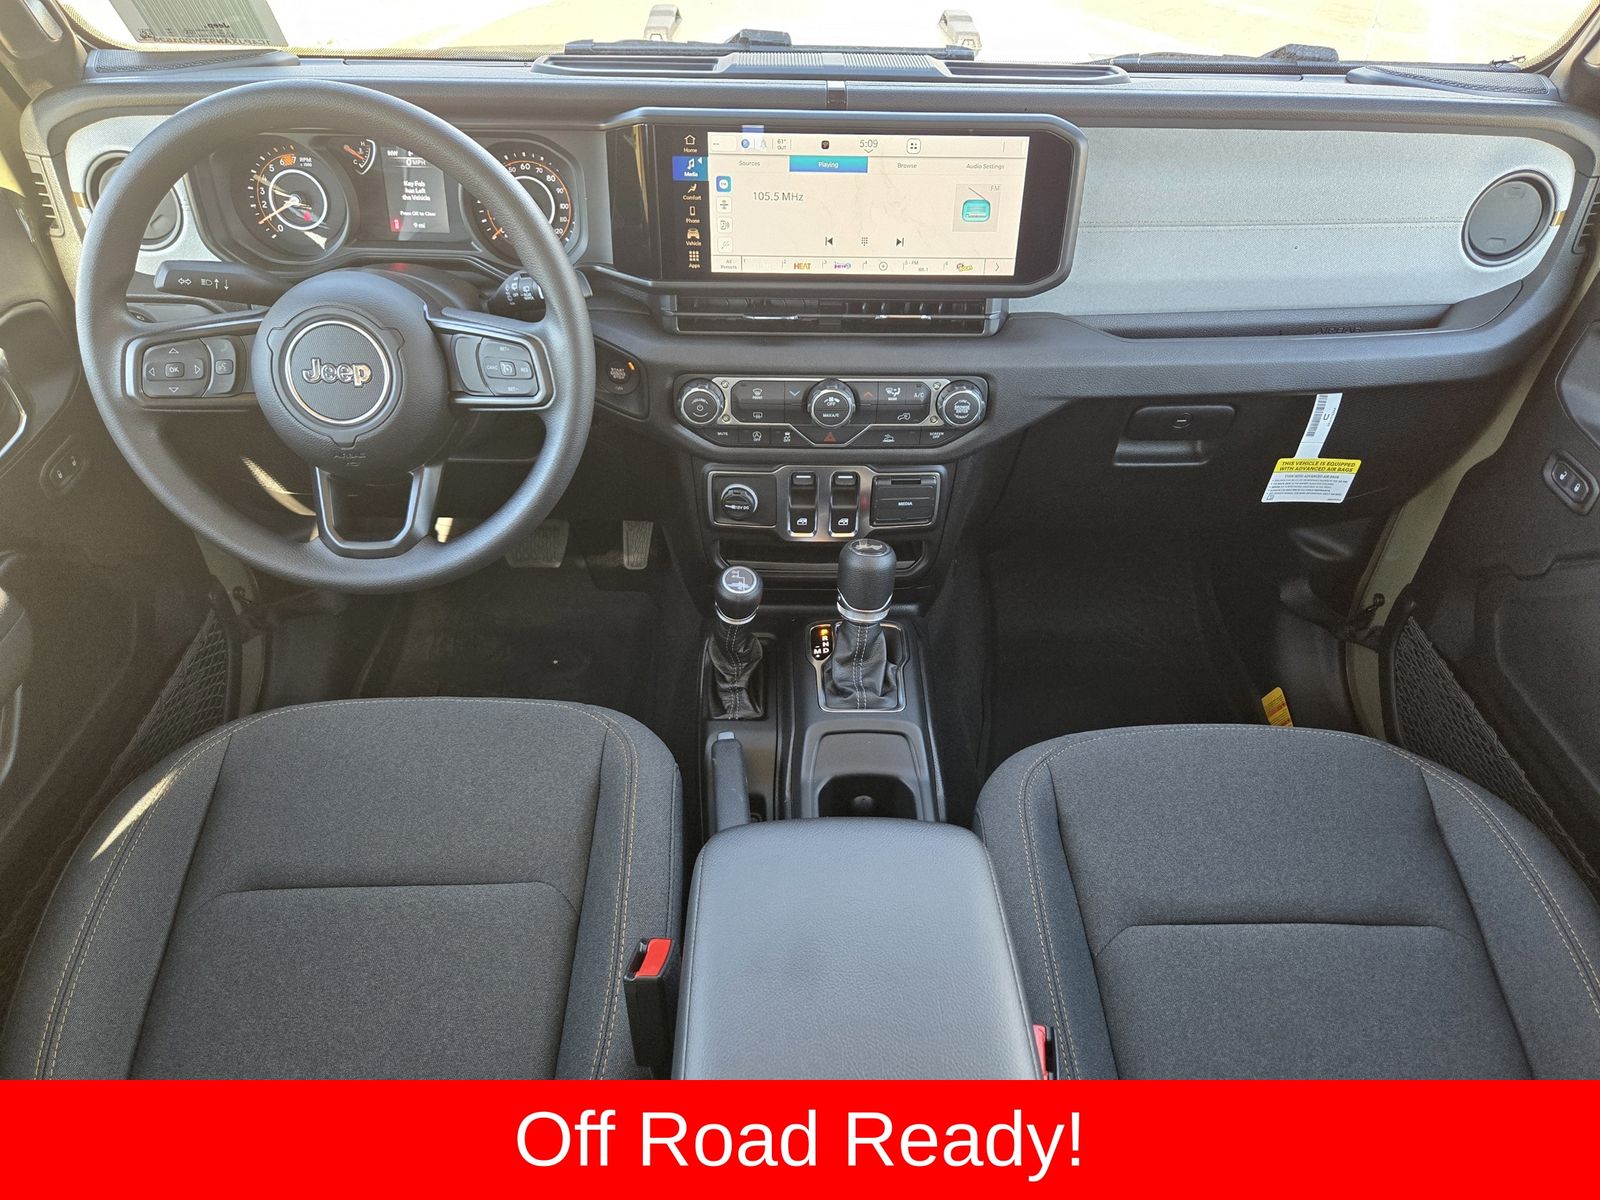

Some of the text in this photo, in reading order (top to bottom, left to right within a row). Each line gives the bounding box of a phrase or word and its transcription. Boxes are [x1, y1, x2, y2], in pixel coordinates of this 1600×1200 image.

[860, 139, 878, 148] 5:09
[269, 164, 274, 172] 5
[818, 161, 839, 169] Playing
[983, 163, 1004, 171] Settings
[262, 174, 267, 182] 4
[753, 191, 804, 201] 105.5 MHz
[262, 200, 267, 209] 2
[278, 224, 283, 232] 0
[793, 262, 811, 270] HEAT
[302, 357, 372, 387] Jeep
[1323, 413, 1330, 421] U
